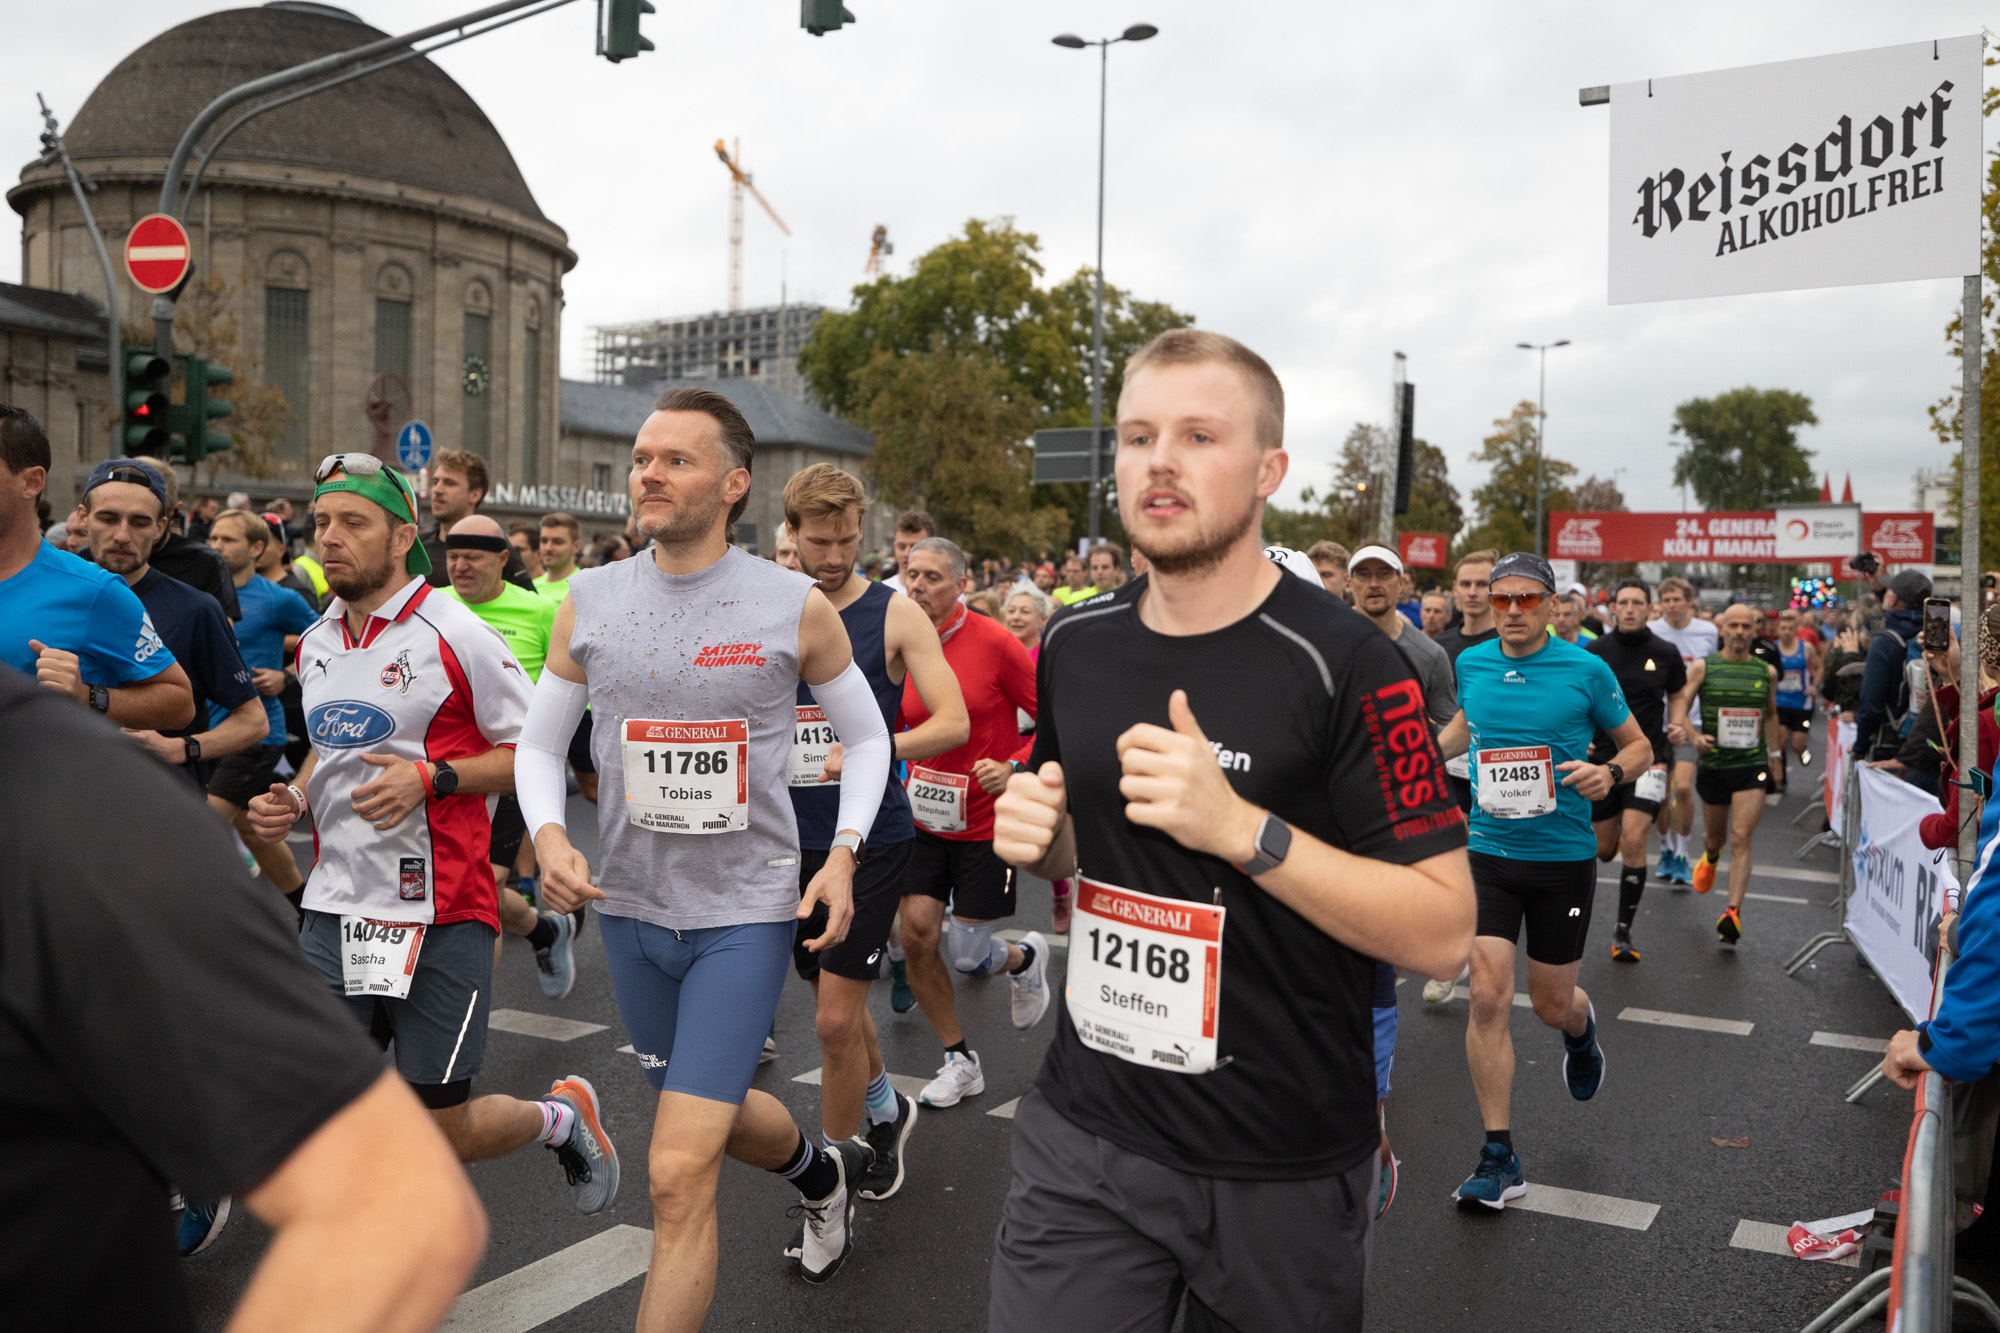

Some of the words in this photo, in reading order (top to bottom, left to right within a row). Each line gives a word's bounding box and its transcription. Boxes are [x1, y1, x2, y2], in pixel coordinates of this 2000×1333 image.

[1632, 79, 1955, 239] Reissdorf
[1715, 156, 1944, 258] ALKOHOLFREI
[1675, 518, 1704, 537] 24.
[1812, 519, 1844, 530] Rhein
[1812, 530, 1855, 541] Energie
[1663, 535, 1710, 557] KÖLN
[698, 643, 763, 657] SATISFY
[693, 654, 768, 668] RUNNING
[317, 707, 371, 739] Ford
[801, 710, 827, 720] GENE
[665, 725, 728, 739] GENERALI
[643, 749, 728, 775] 11786
[1501, 750, 1539, 760] GENERALI
[926, 773, 957, 786] GENERALI
[1489, 765, 1541, 783] 12483
[659, 785, 713, 800] Tobias
[914, 783, 956, 804] 22223
[1500, 788, 1532, 798] Volker
[655, 813, 685, 822] GENERALI
[917, 803, 951, 817] Stephan
[640, 818, 655, 828] KÖLN
[656, 820, 690, 830] MARATHON
[703, 820, 728, 830] PUMA
[1112, 898, 1192, 932] GENERALI
[343, 921, 408, 945] 14049
[350, 952, 387, 966] Sascha
[1089, 927, 1190, 984] 12168
[368, 983, 390, 993] PUMA
[1100, 984, 1169, 1018] Steffen
[1094, 1023, 1131, 1042] GENERALI
[1095, 1034, 1136, 1055] MARATHON
[1152, 1048, 1186, 1067] PUMA
[579, 1117, 604, 1160] HOKA
